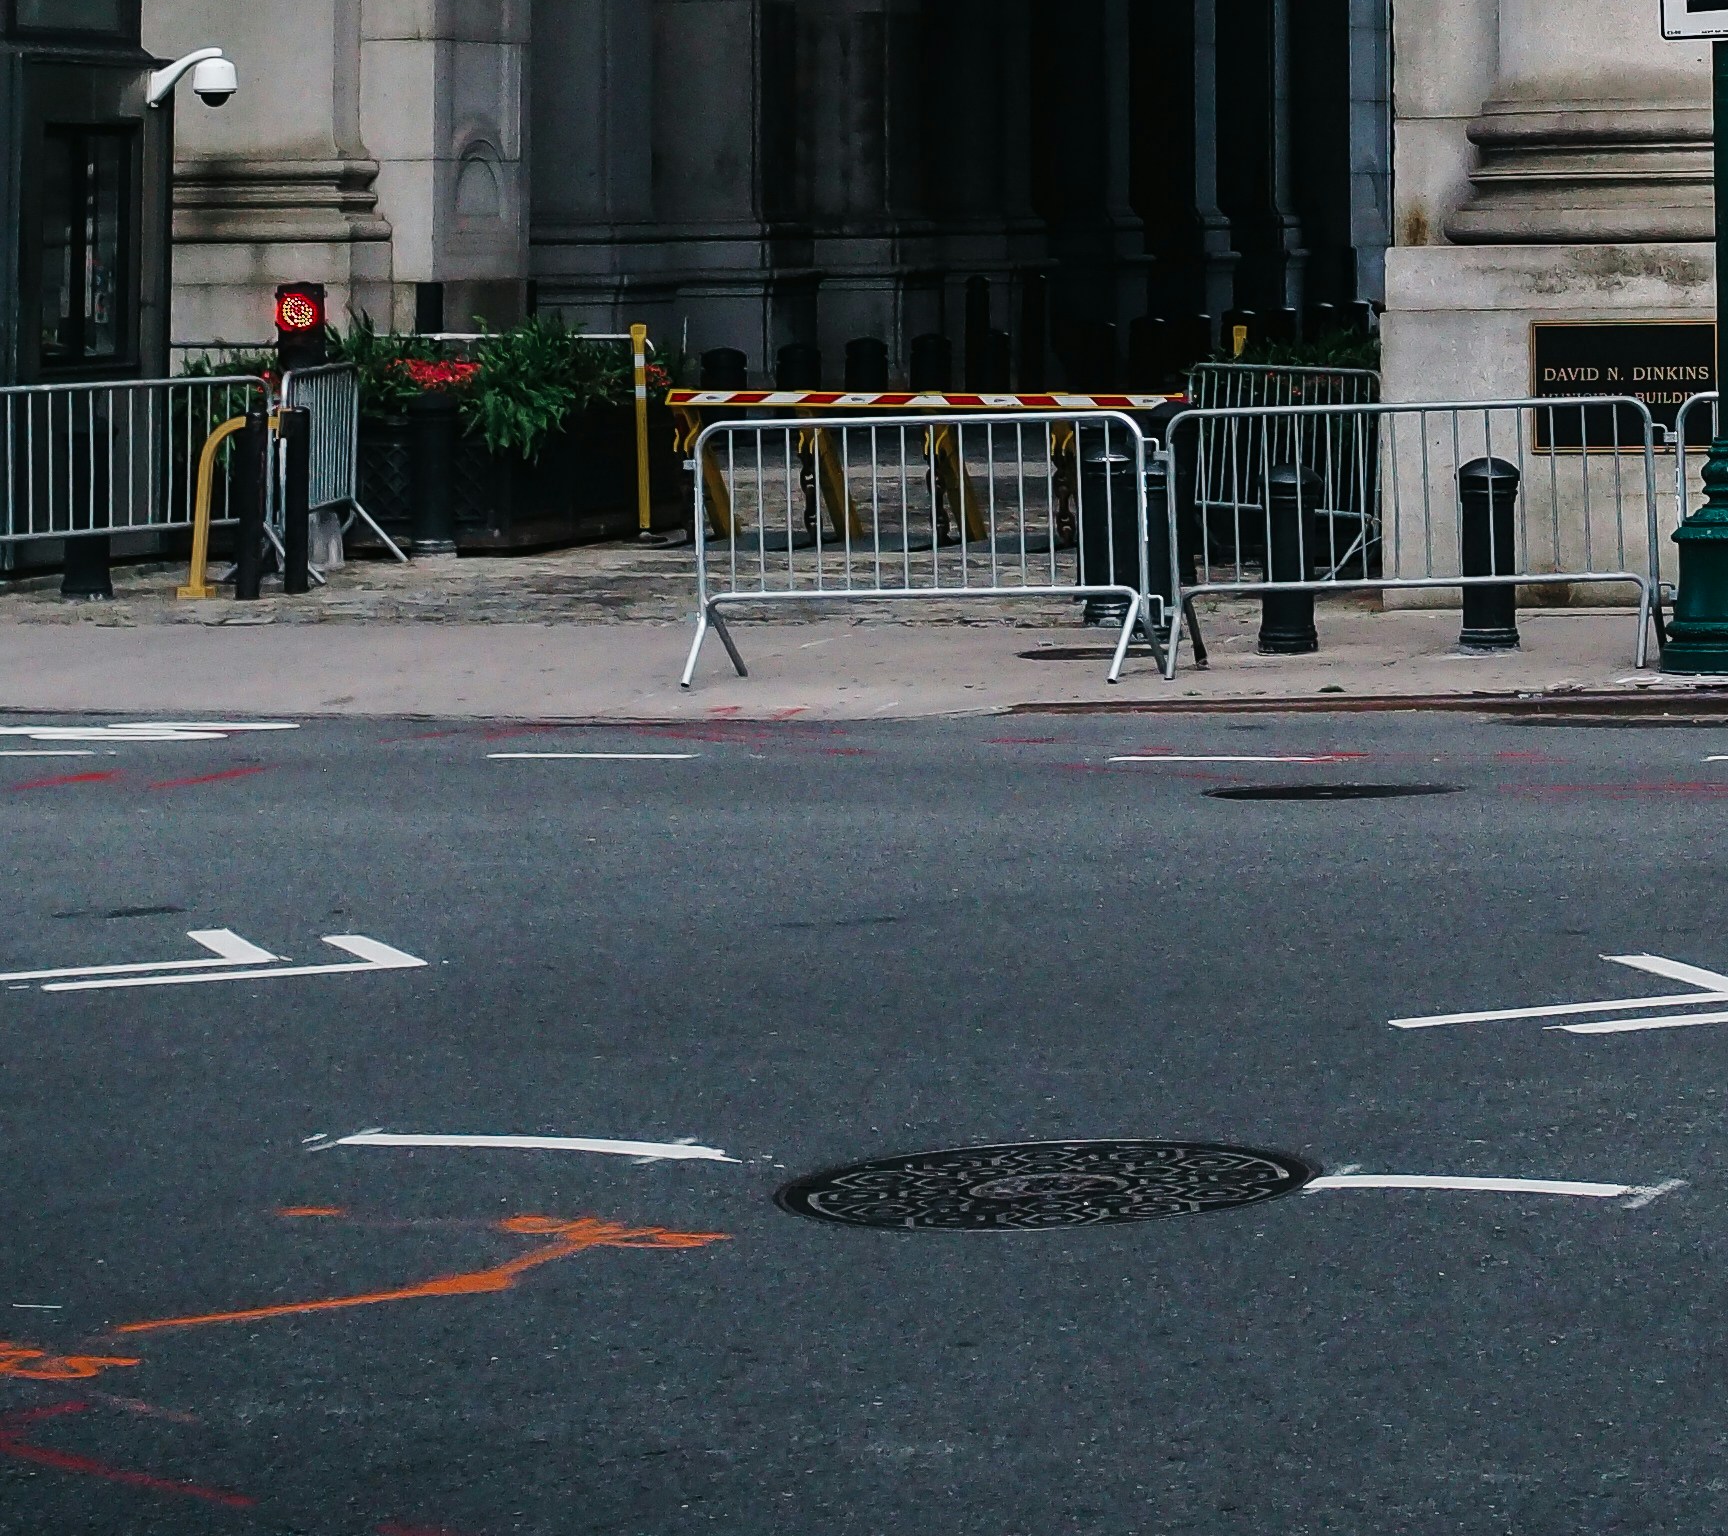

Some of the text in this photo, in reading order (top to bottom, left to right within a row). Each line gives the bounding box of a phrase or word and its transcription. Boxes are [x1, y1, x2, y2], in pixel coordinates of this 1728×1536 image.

[1543, 366, 1710, 382] DAVID N. DINKINS
[1634, 391, 1711, 405] BUILDI
